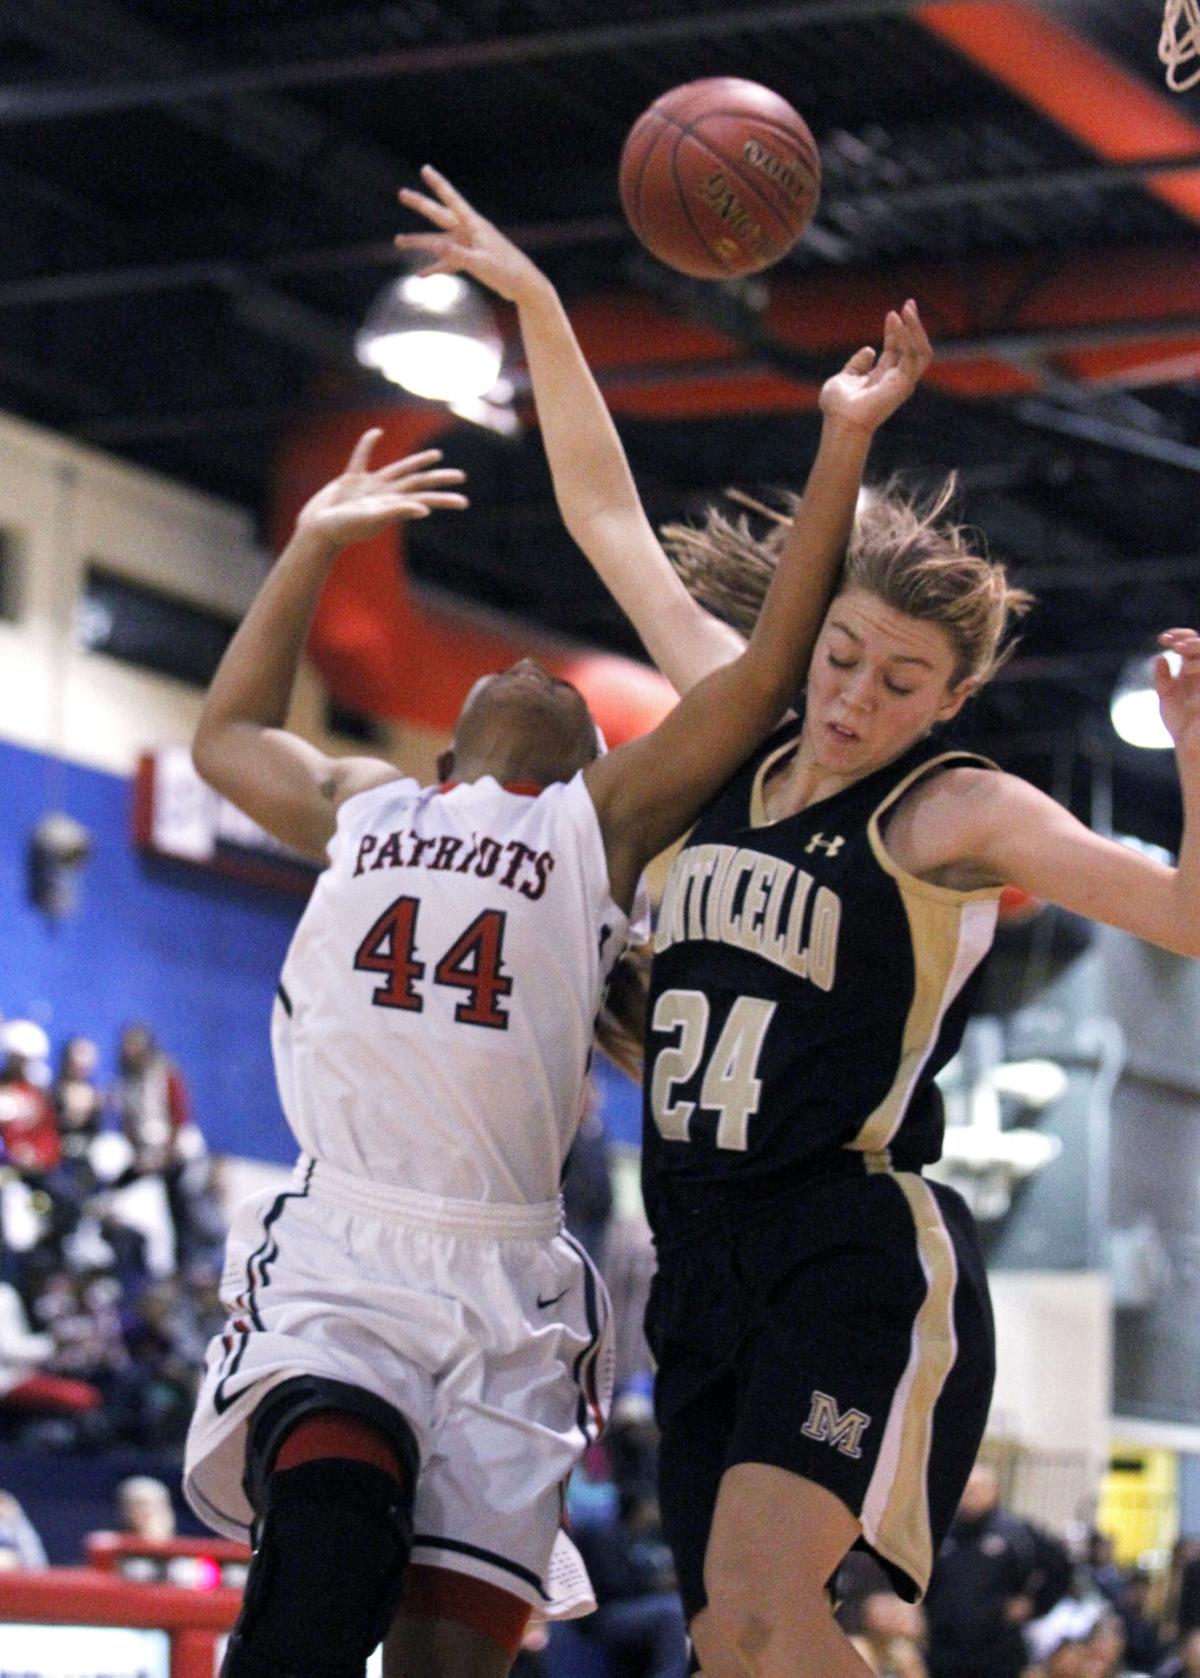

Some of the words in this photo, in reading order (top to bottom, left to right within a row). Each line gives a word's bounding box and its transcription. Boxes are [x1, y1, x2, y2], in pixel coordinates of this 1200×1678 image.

[353, 829, 555, 901] PATRIOTS
[353, 894, 514, 1031] 44
[651, 988, 777, 1151] 24
[800, 1390, 871, 1459] M
